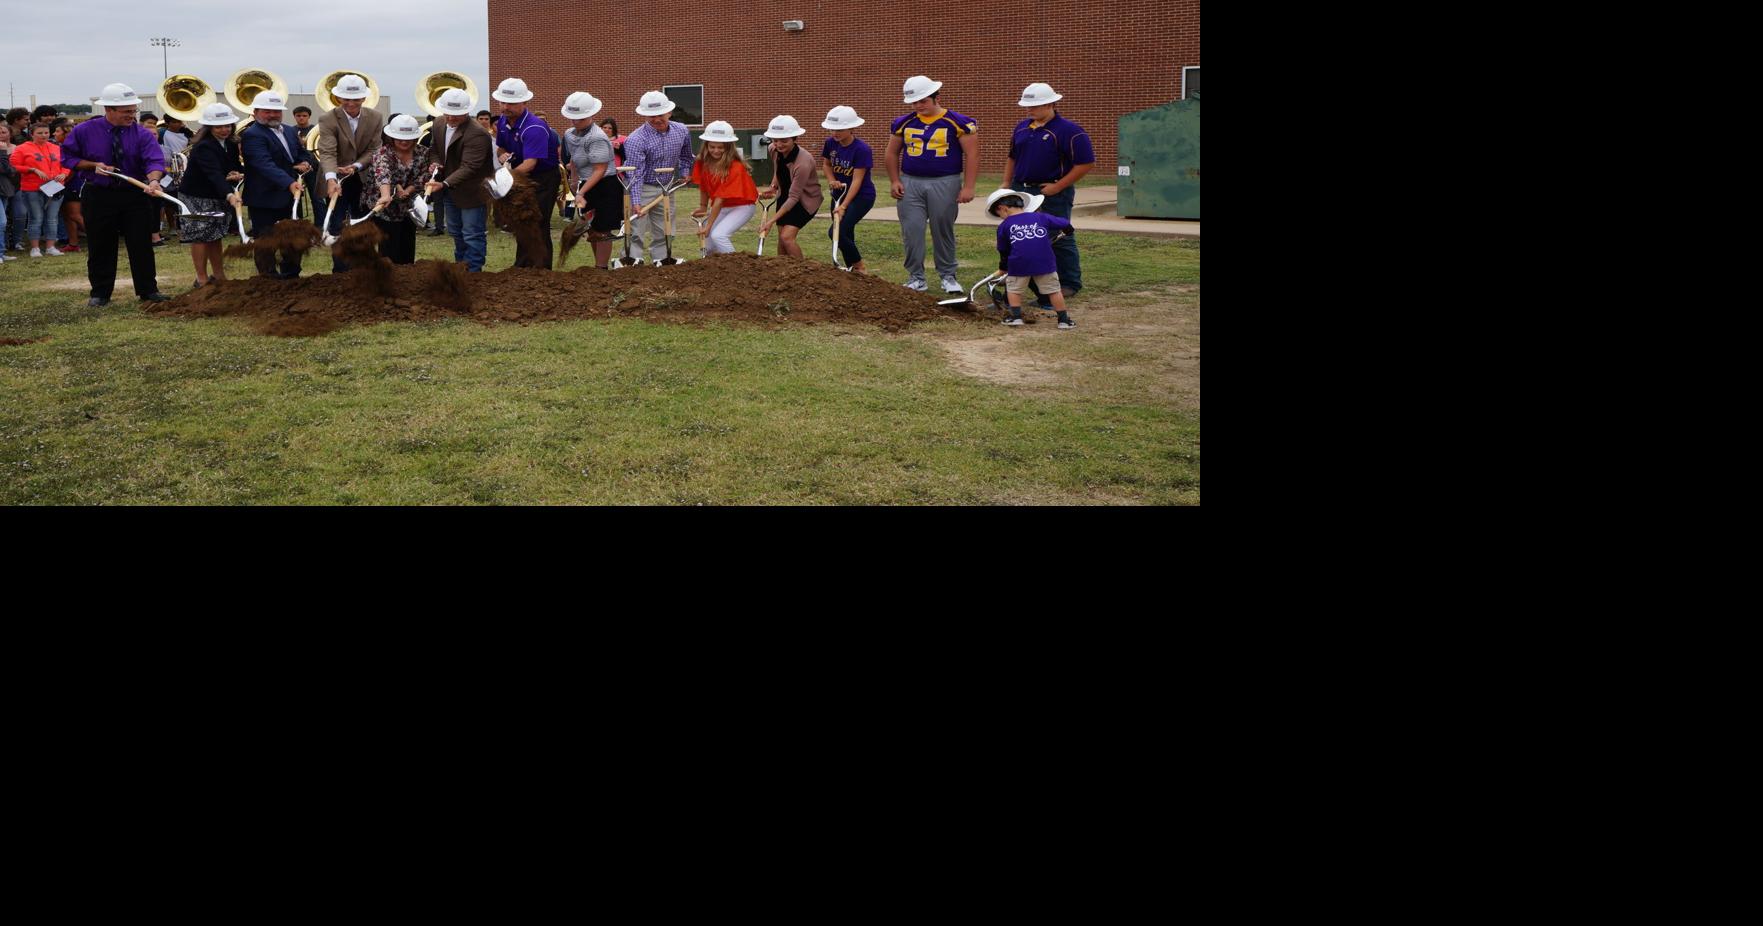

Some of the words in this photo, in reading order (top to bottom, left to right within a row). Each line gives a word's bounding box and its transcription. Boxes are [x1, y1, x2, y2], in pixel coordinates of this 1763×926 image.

[904, 127, 949, 157] 54
[1010, 224, 1028, 234] Class
[1029, 222, 1038, 230] of
